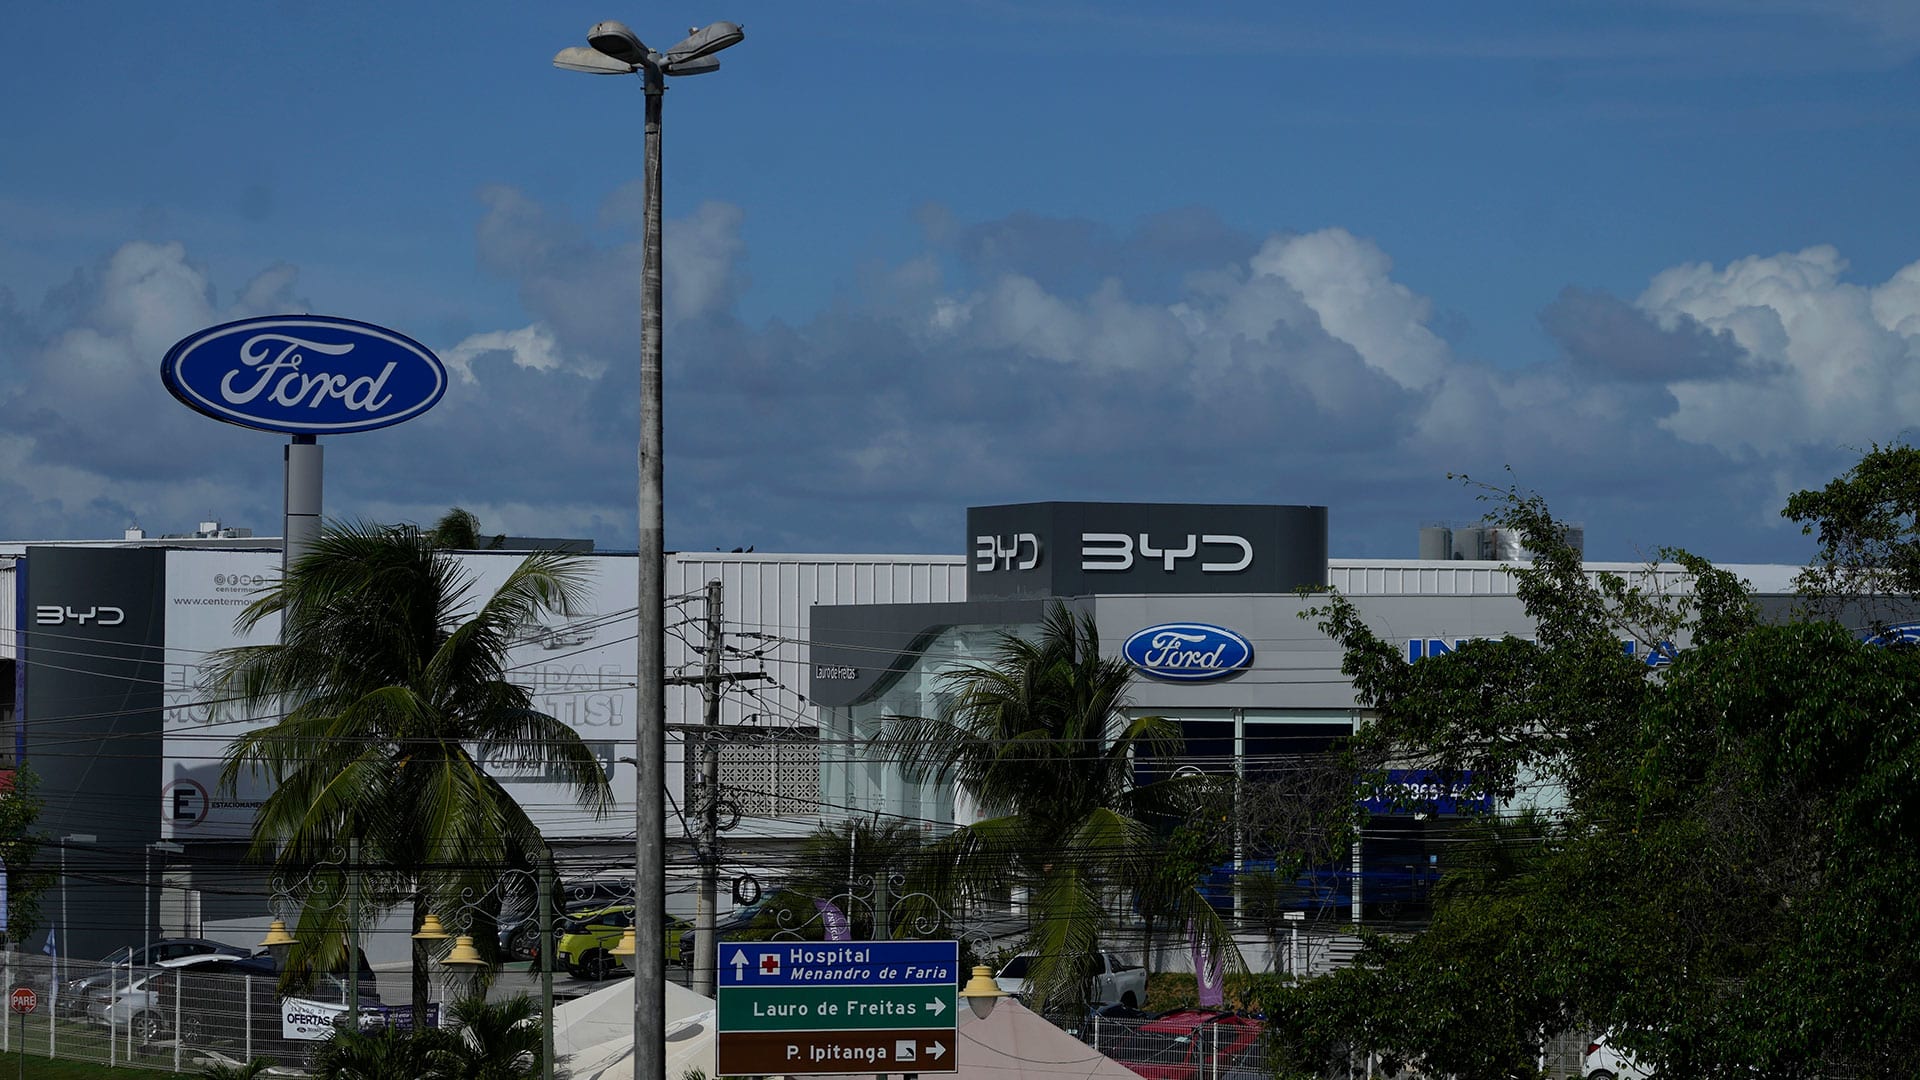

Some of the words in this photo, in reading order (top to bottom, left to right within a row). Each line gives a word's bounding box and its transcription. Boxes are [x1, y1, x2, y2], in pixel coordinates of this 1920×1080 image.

[220, 333, 398, 412] Ford
[976, 532, 1039, 573] BYD
[1081, 532, 1254, 573] BYD
[173, 597, 257, 606] www.centermov
[36, 605, 125, 625] BYD
[1144, 632, 1228, 669] Ford
[790, 948, 870, 966] Hospital
[790, 967, 871, 981] Menandro
[879, 966, 897, 980] de
[905, 966, 948, 979] Faria
[13, 995, 35, 1006] PARE
[753, 1001, 809, 1017] Lauro
[817, 1001, 839, 1016] de
[847, 1000, 917, 1016] Freitas
[287, 1013, 330, 1026] OFERTAS
[786, 1044, 802, 1060] P.
[809, 1043, 887, 1064] Ipitanga
